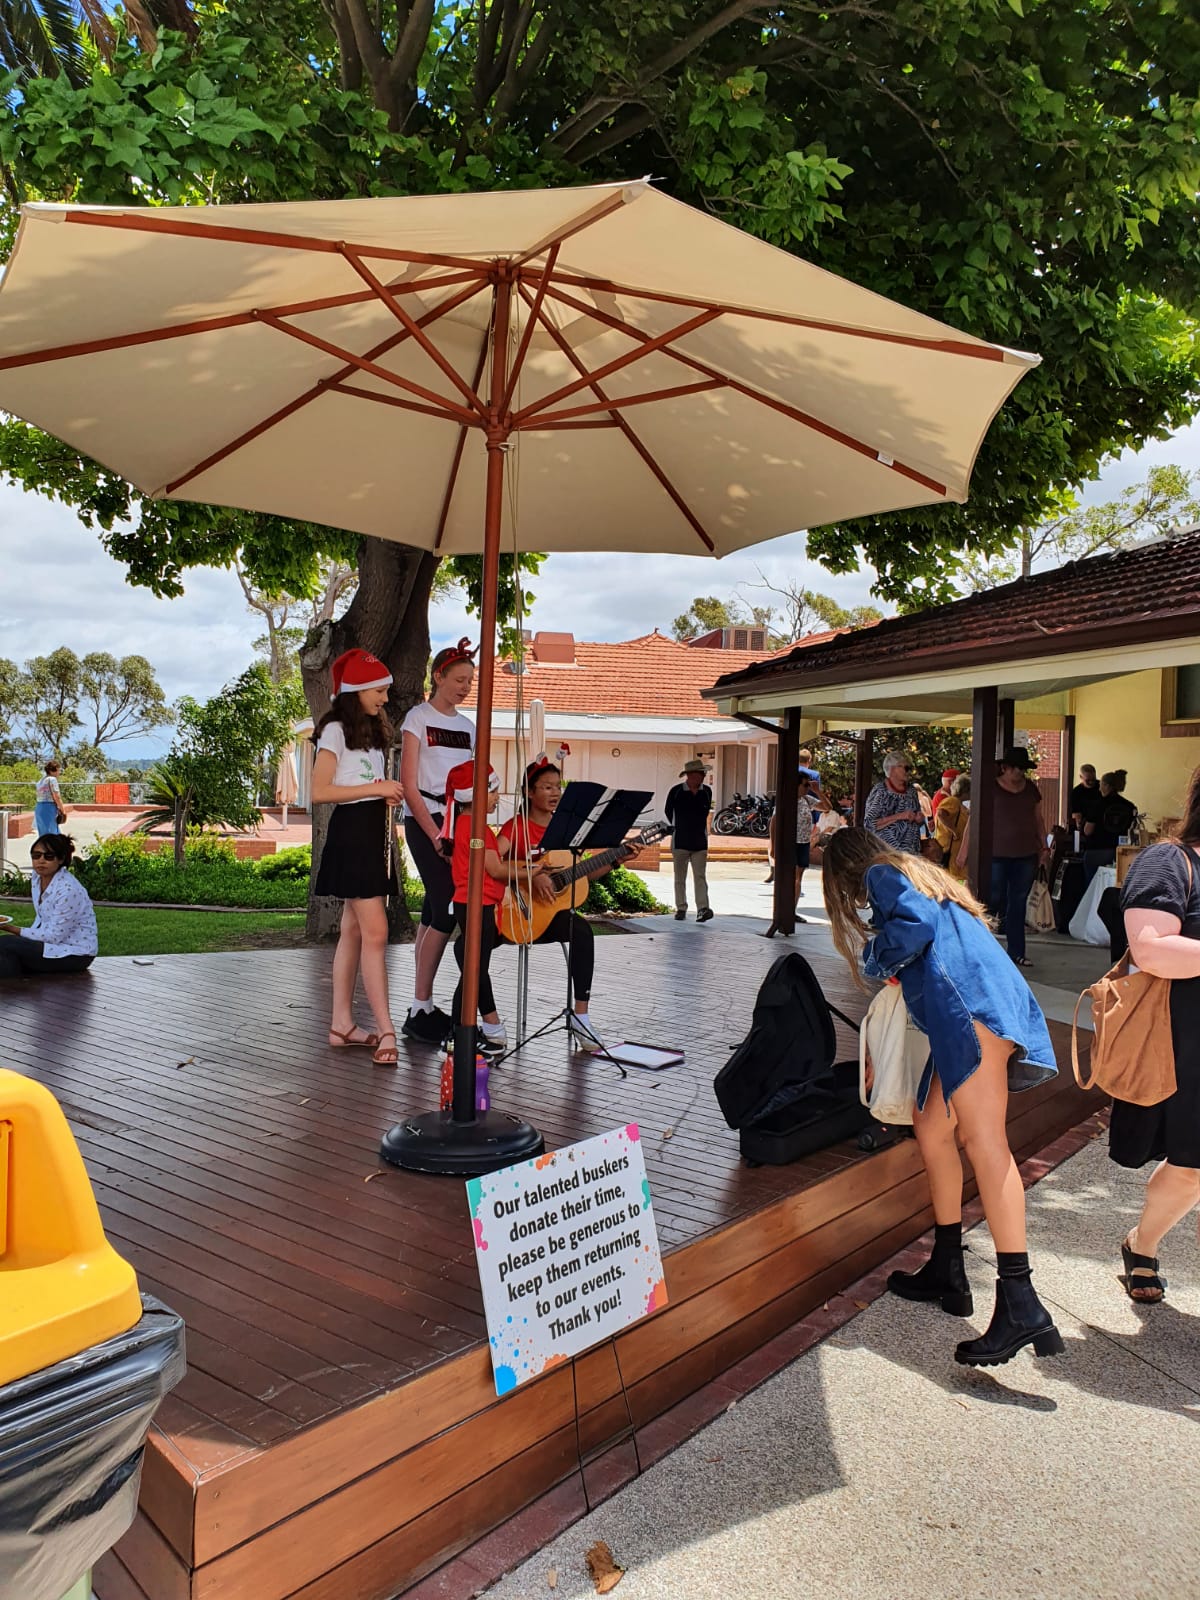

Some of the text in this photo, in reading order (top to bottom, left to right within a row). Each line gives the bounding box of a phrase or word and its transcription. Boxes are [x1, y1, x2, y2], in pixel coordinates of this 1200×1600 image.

[494, 1156, 629, 1219] Our talented buskers
[510, 1186, 625, 1242] donate their time,
[498, 1204, 640, 1282] please be generous to
[507, 1229, 641, 1302] keep them returning
[535, 1265, 626, 1318] to our events.
[548, 1288, 622, 1340] Thank you!
